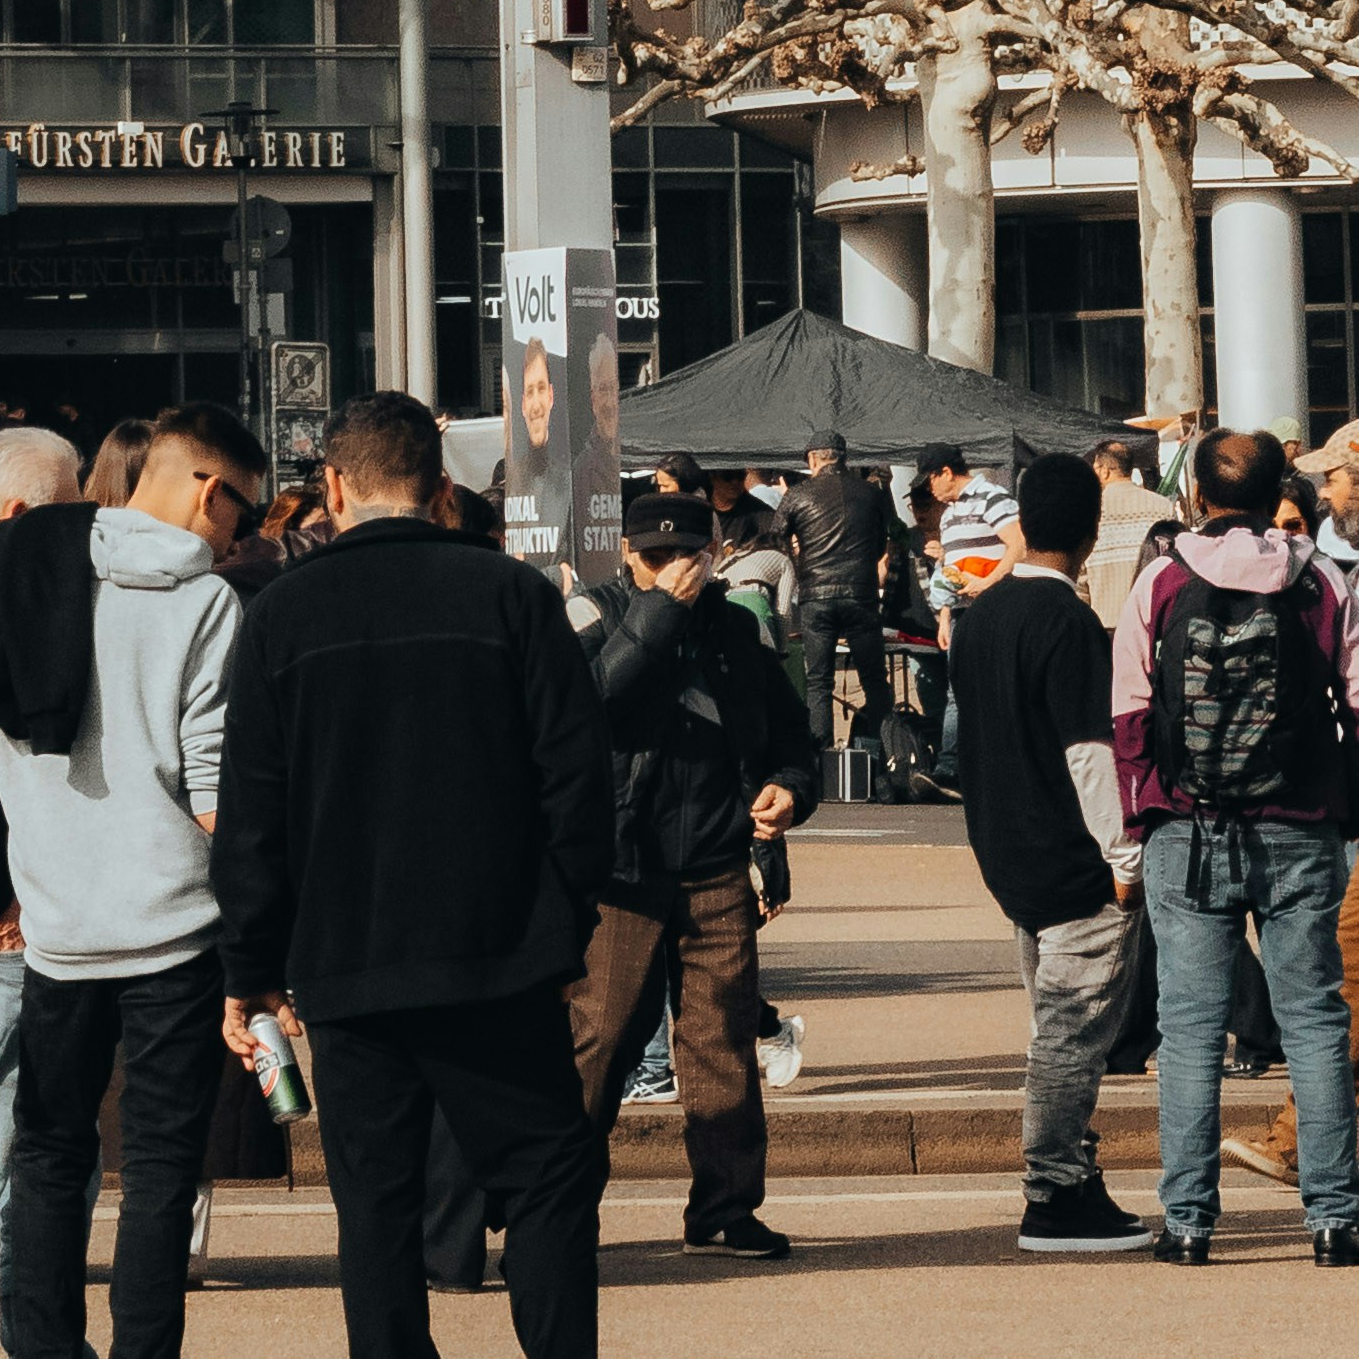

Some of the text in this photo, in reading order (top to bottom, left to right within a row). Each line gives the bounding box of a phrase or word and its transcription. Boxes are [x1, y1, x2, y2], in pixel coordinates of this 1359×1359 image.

[180, 122, 346, 169] GAERIE
[515, 275, 557, 324] Volt
[615, 296, 660, 319] OUS
